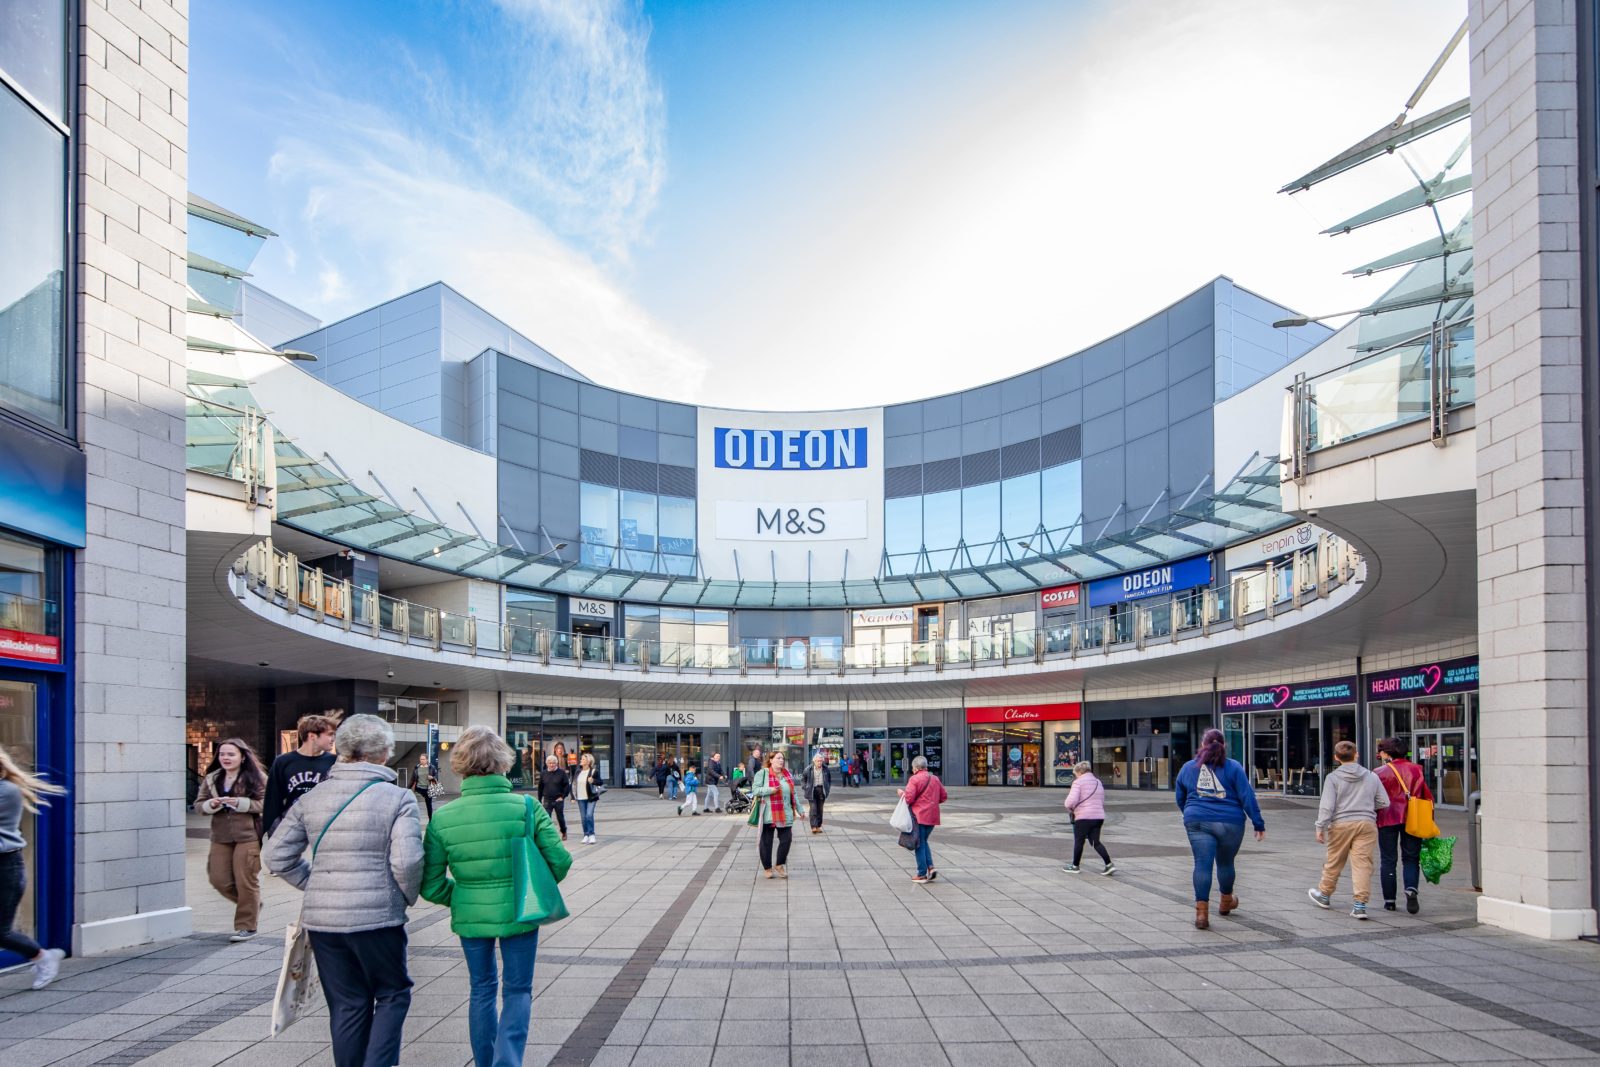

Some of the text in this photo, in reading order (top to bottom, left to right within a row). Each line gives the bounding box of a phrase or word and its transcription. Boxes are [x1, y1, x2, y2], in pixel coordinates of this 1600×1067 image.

[724, 428, 856, 469] ODEON
[757, 507, 826, 535] M&S
[1262, 535, 1295, 553] tenpin
[1123, 567, 1171, 592] ODEON
[1043, 590, 1076, 603] COSTA
[578, 601, 606, 615] M&S
[857, 611, 908, 624] Nando's
[1372, 674, 1425, 693] HEART ROCK
[1226, 692, 1275, 706] HEART ROCK
[664, 713, 695, 725] M&S
[1004, 708, 1040, 720] Clintons
